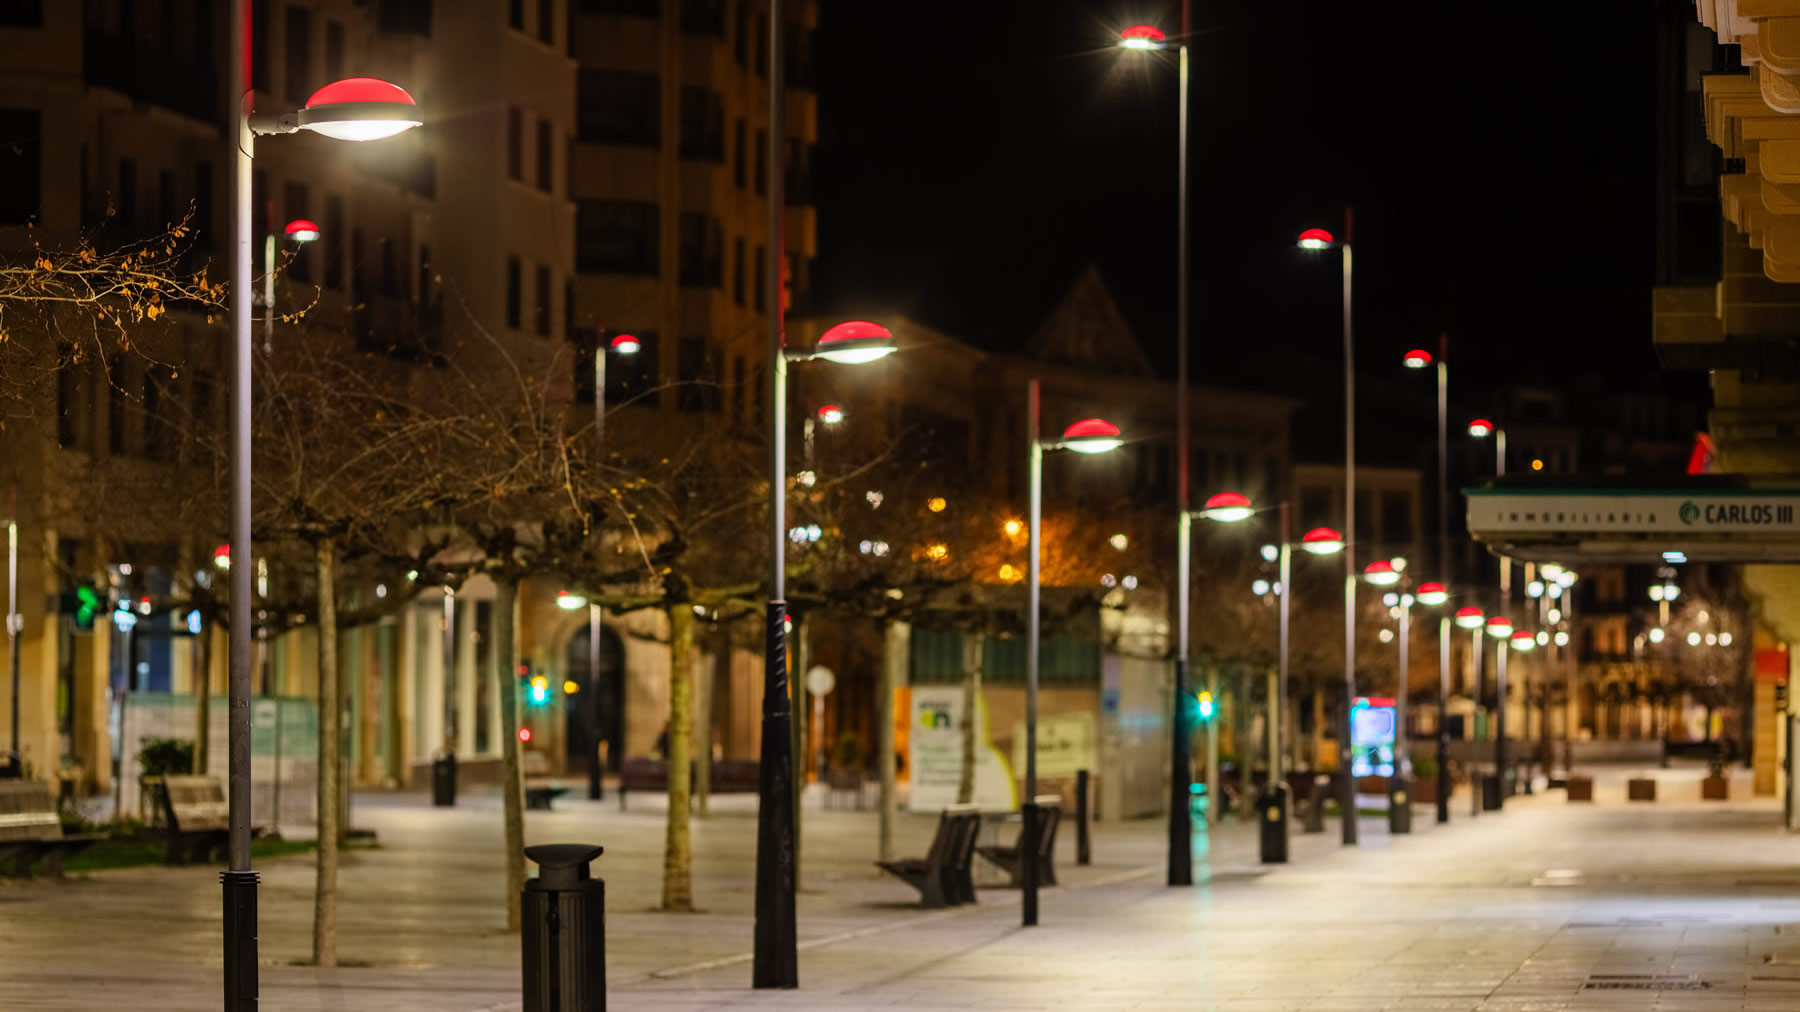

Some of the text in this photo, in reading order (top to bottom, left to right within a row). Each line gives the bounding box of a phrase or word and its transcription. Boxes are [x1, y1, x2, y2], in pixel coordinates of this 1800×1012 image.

[1498, 512, 1656, 523] INMOBILIARIA
[1705, 504, 1793, 524] CARLOS III
